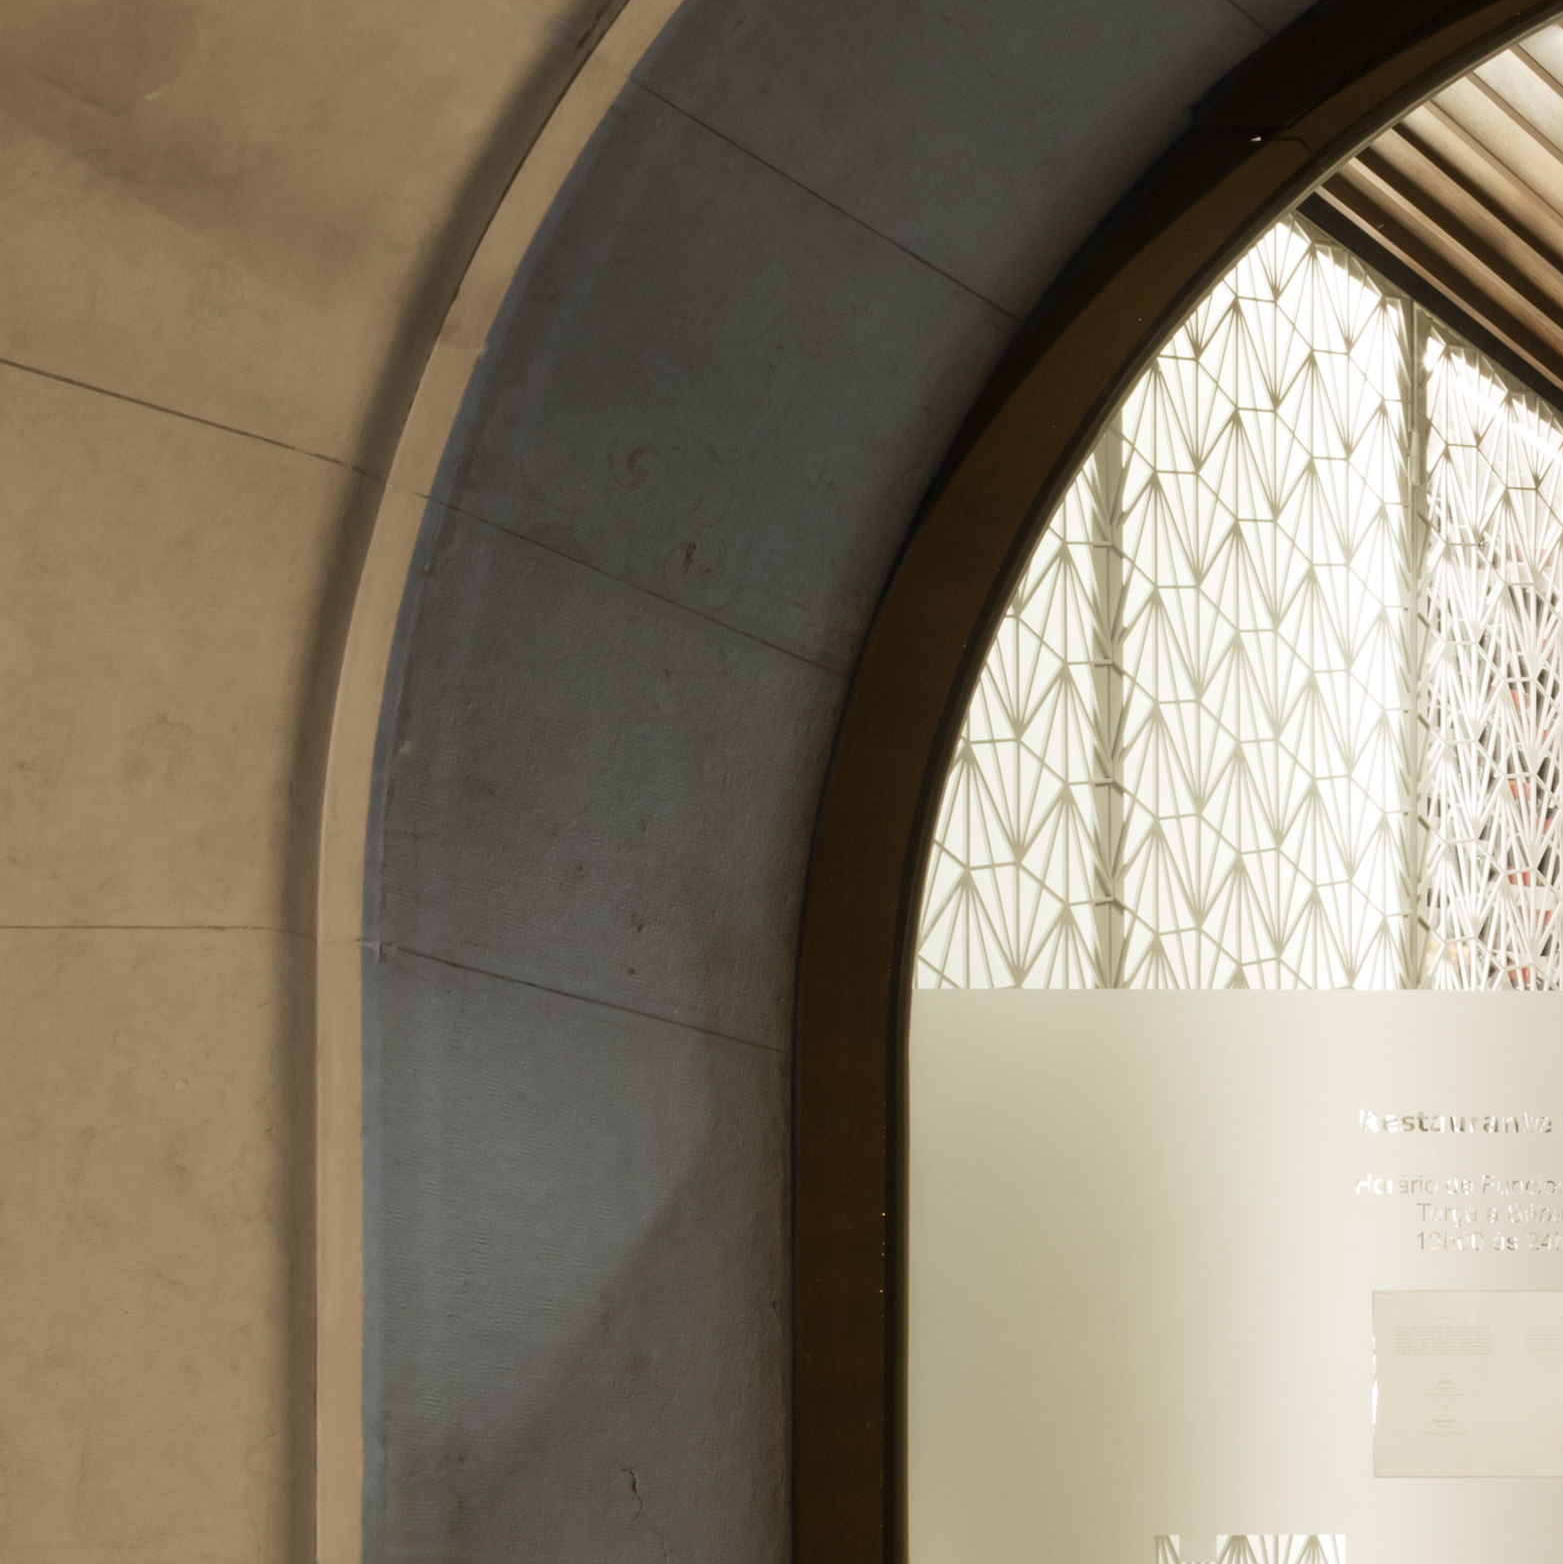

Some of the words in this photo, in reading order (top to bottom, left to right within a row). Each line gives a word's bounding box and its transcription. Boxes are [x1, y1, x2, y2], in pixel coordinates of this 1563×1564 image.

[1359, 1110, 1552, 1134] Restaurante
[1355, 1174, 1438, 1195] Horário
[1446, 1175, 1474, 1195] de
